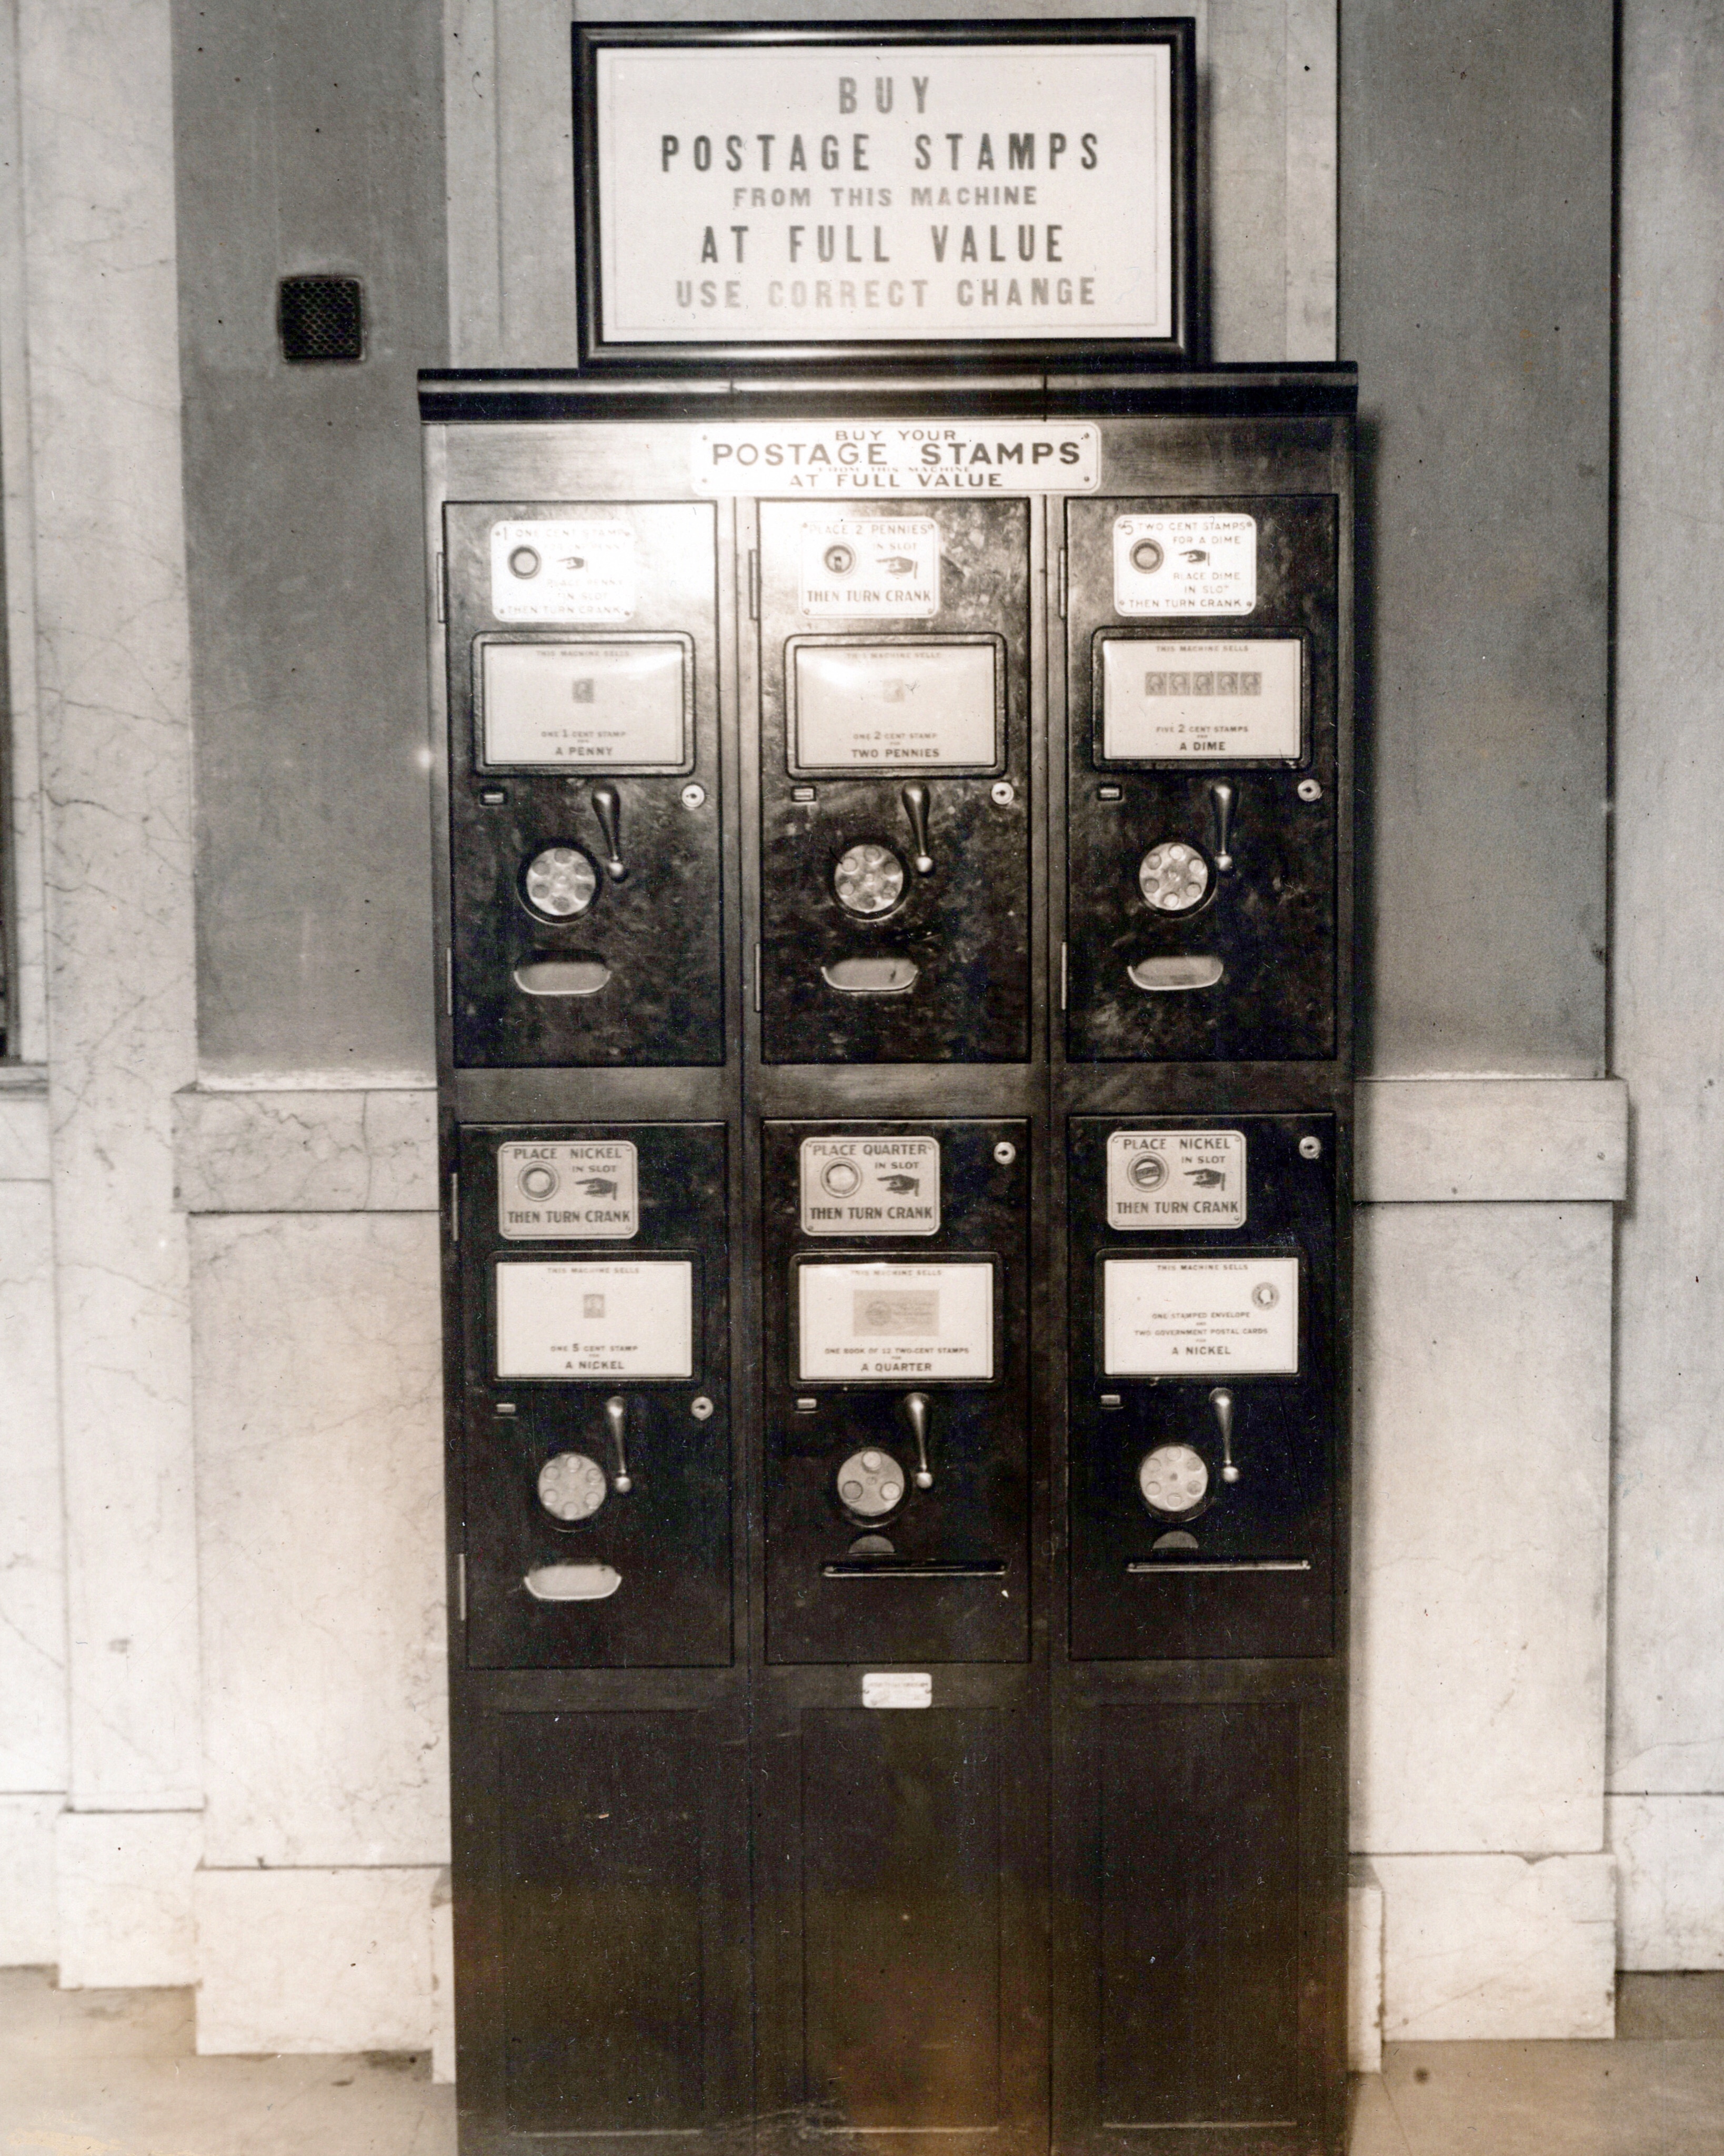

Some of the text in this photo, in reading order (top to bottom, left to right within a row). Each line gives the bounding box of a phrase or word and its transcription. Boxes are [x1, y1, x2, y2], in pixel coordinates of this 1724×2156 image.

[838, 76, 931, 115] BUY
[661, 132, 1100, 173] POSTAGE STAMPS
[734, 186, 1036, 207] FROM THIS MACHINE
[701, 225, 1064, 263] AT FULL VALUE
[676, 276, 1096, 308] USE CORRECT CHANGE
[835, 430, 957, 441] BUY YOUR
[713, 442, 1080, 466] POSTAGE STAMPS
[789, 473, 1004, 487] AT FULL VALUE
[856, 525, 863, 535] 2
[871, 524, 928, 534] PENNIES
[1124, 520, 1246, 535] 5 TWO CENT STAMPS
[1212, 536, 1241, 544] DIME
[1203, 585, 1229, 594] SLOT
[807, 590, 930, 602] THEN TURN CRANK
[1129, 599, 1242, 607] THEN TURN CRANK
[1178, 724, 1185, 733] 2
[874, 731, 881, 740] 2
[555, 746, 613, 756] A PENNY
[1180, 742, 1226, 751] A DIME
[851, 748, 940, 758] TWO PENNIES
[1124, 1139, 1230, 1149] PLACE NICKEL
[514, 1147, 622, 1159] PLACE NICKEL
[813, 1144, 927, 1156] PLACE QUARTER
[1116, 1201, 1238, 1214] THEN TURN CRANK
[508, 1211, 630, 1223] THEN TURN CRANK
[810, 1207, 933, 1220] THEN TURN CRANK
[573, 1343, 579, 1352] 5
[1186, 1346, 1231, 1355] NICKEL
[579, 1361, 624, 1370] NICKEL
[876, 1363, 932, 1372] QUARTER
